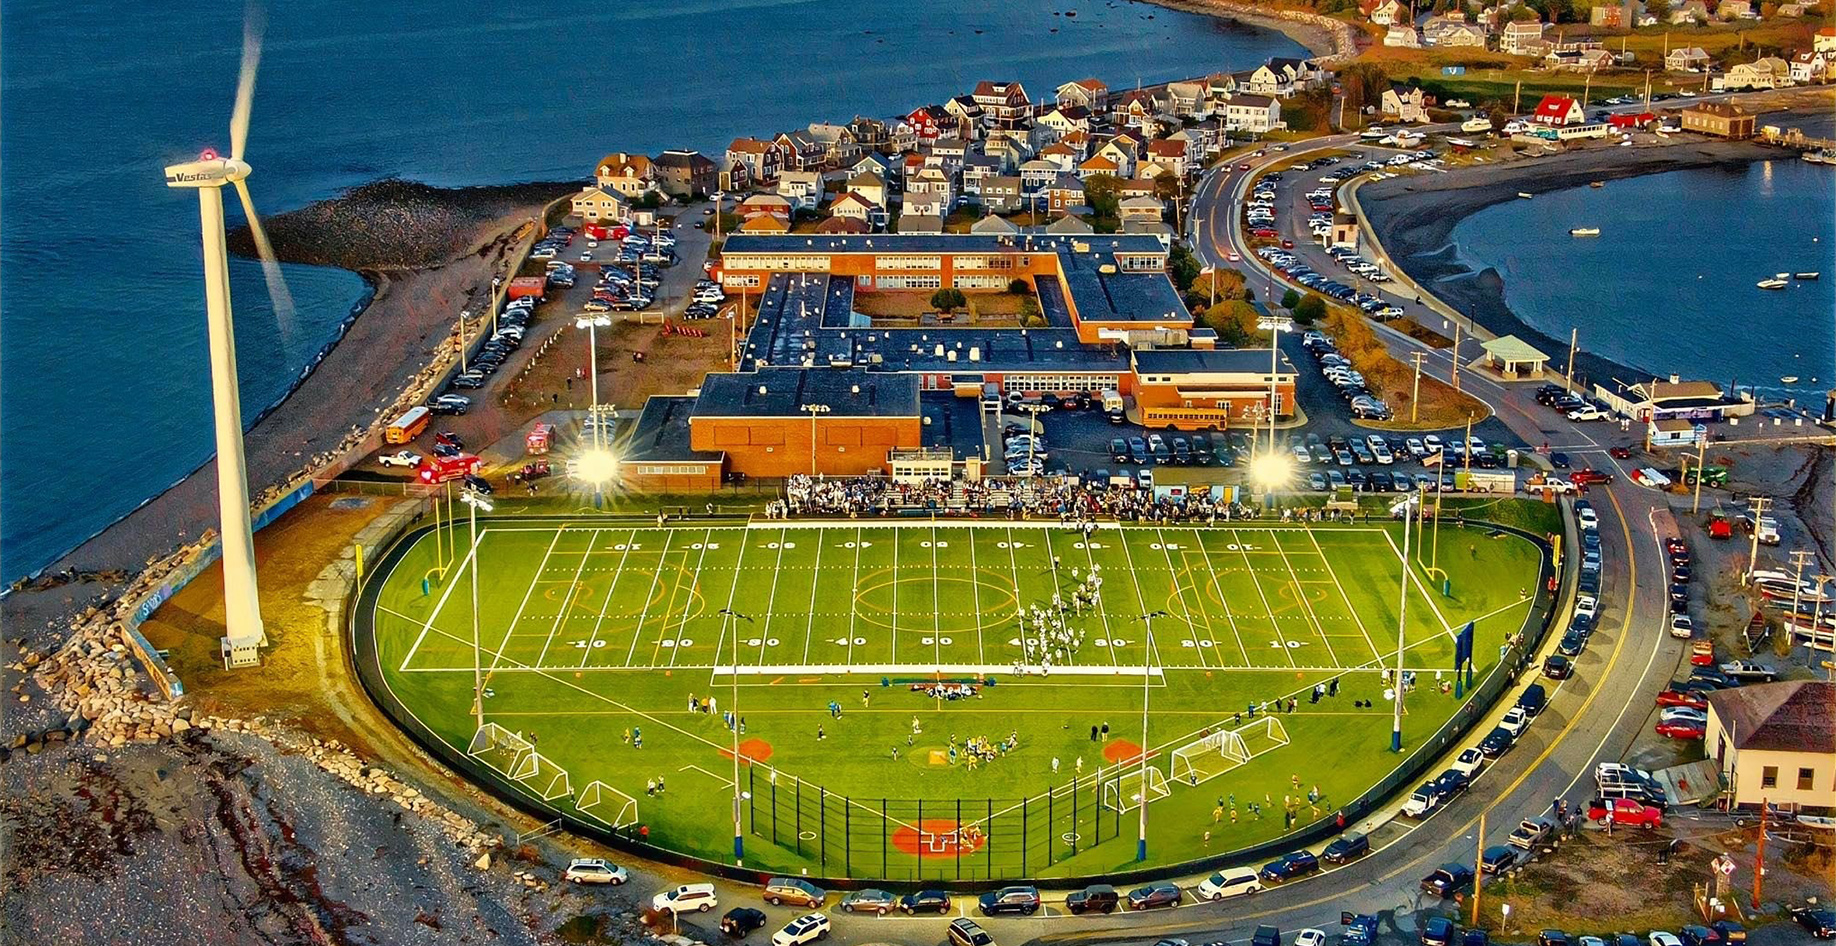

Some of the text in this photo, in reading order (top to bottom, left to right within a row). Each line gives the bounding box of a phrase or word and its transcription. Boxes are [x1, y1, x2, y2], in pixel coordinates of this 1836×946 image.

[176, 172, 212, 182] Vestas
[575, 639, 607, 648] 10
[921, 637, 953, 645] 50
